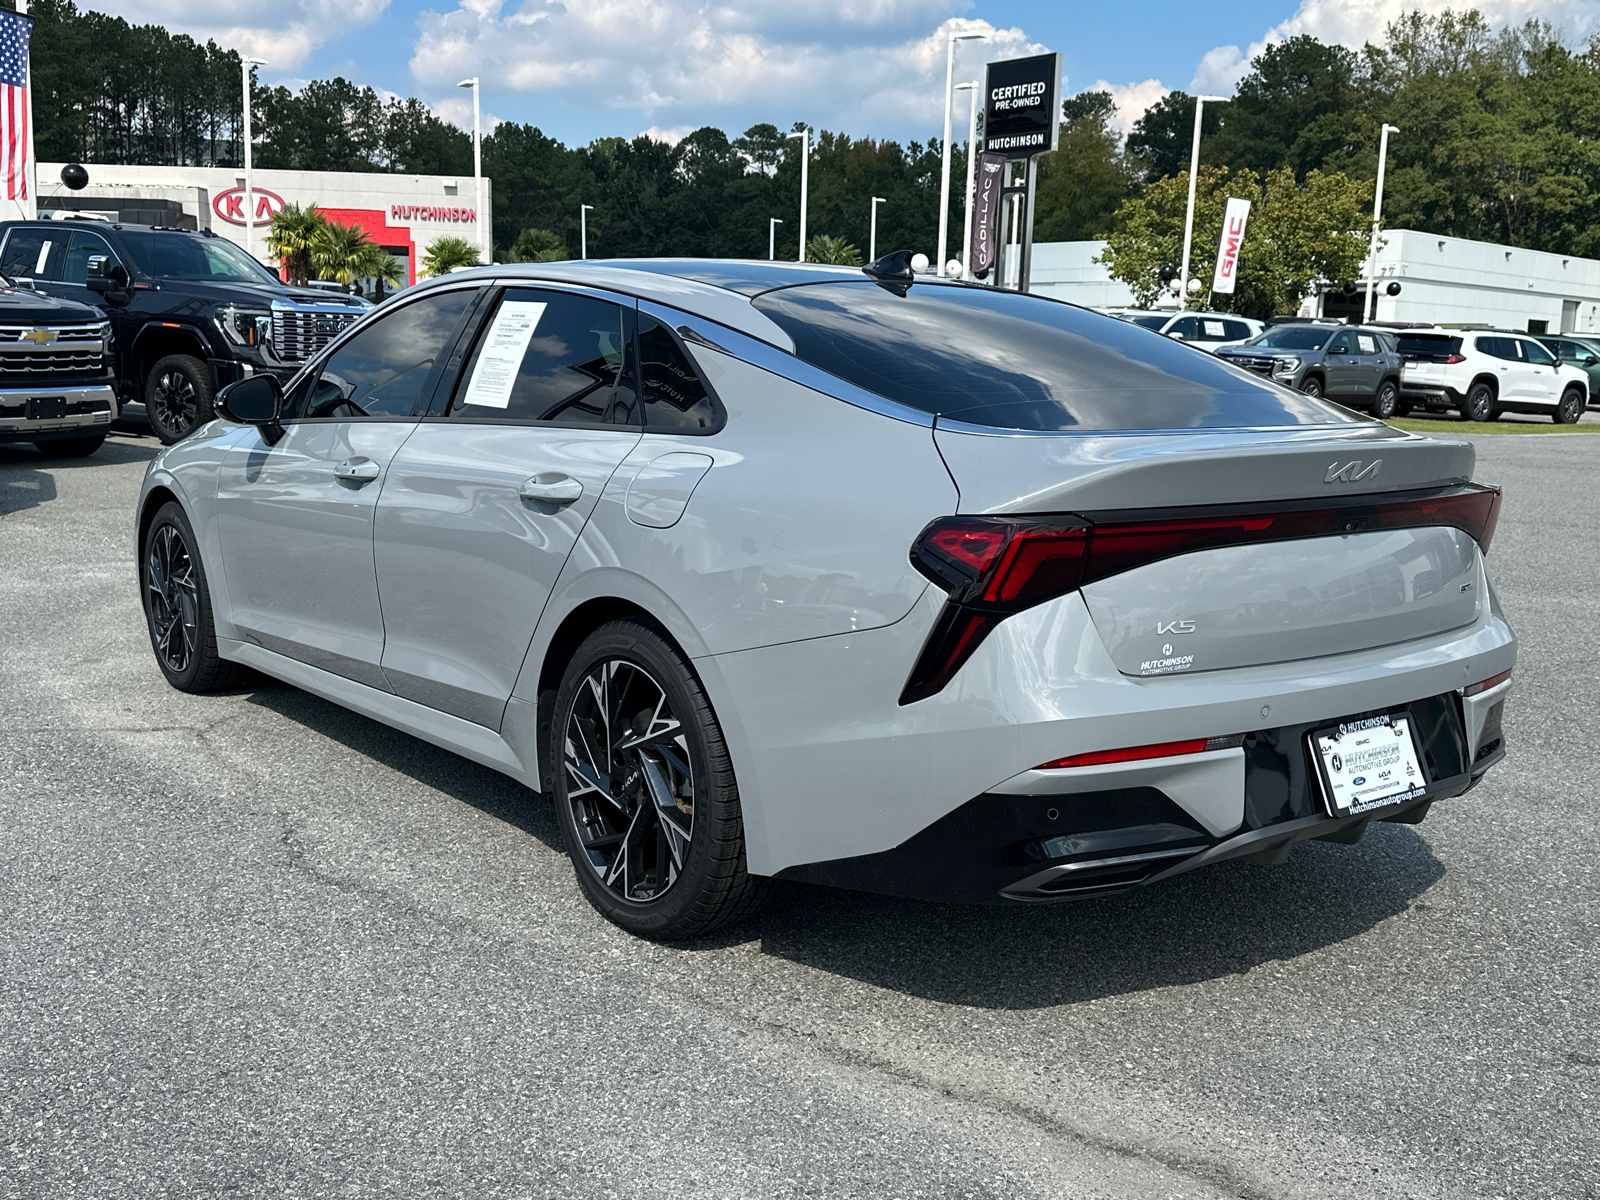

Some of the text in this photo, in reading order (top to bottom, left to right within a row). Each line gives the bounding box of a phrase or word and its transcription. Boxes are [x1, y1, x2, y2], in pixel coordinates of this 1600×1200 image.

[991, 81, 1046, 101] CERTIFIED
[995, 96, 1041, 111] PRE-OWNED
[988, 133, 1044, 150] HUTCHINSON
[225, 194, 274, 218] KA
[391, 204, 477, 222] HUTCHINSON
[979, 178, 992, 265] CADILLAC
[1220, 216, 1243, 278] GMC
[1156, 619, 1196, 635] K5
[1140, 654, 1194, 670] HUTCHINSON
[1141, 663, 1191, 676] AUTOMOTIVE GROUP
[1347, 714, 1390, 732] HUTCHINSON
[1344, 742, 1401, 767] HUTCHINSON
[1348, 755, 1401, 775] AUTOMOTIVE GROUP
[1348, 787, 1426, 815] Hutchinsonautogroup.com
